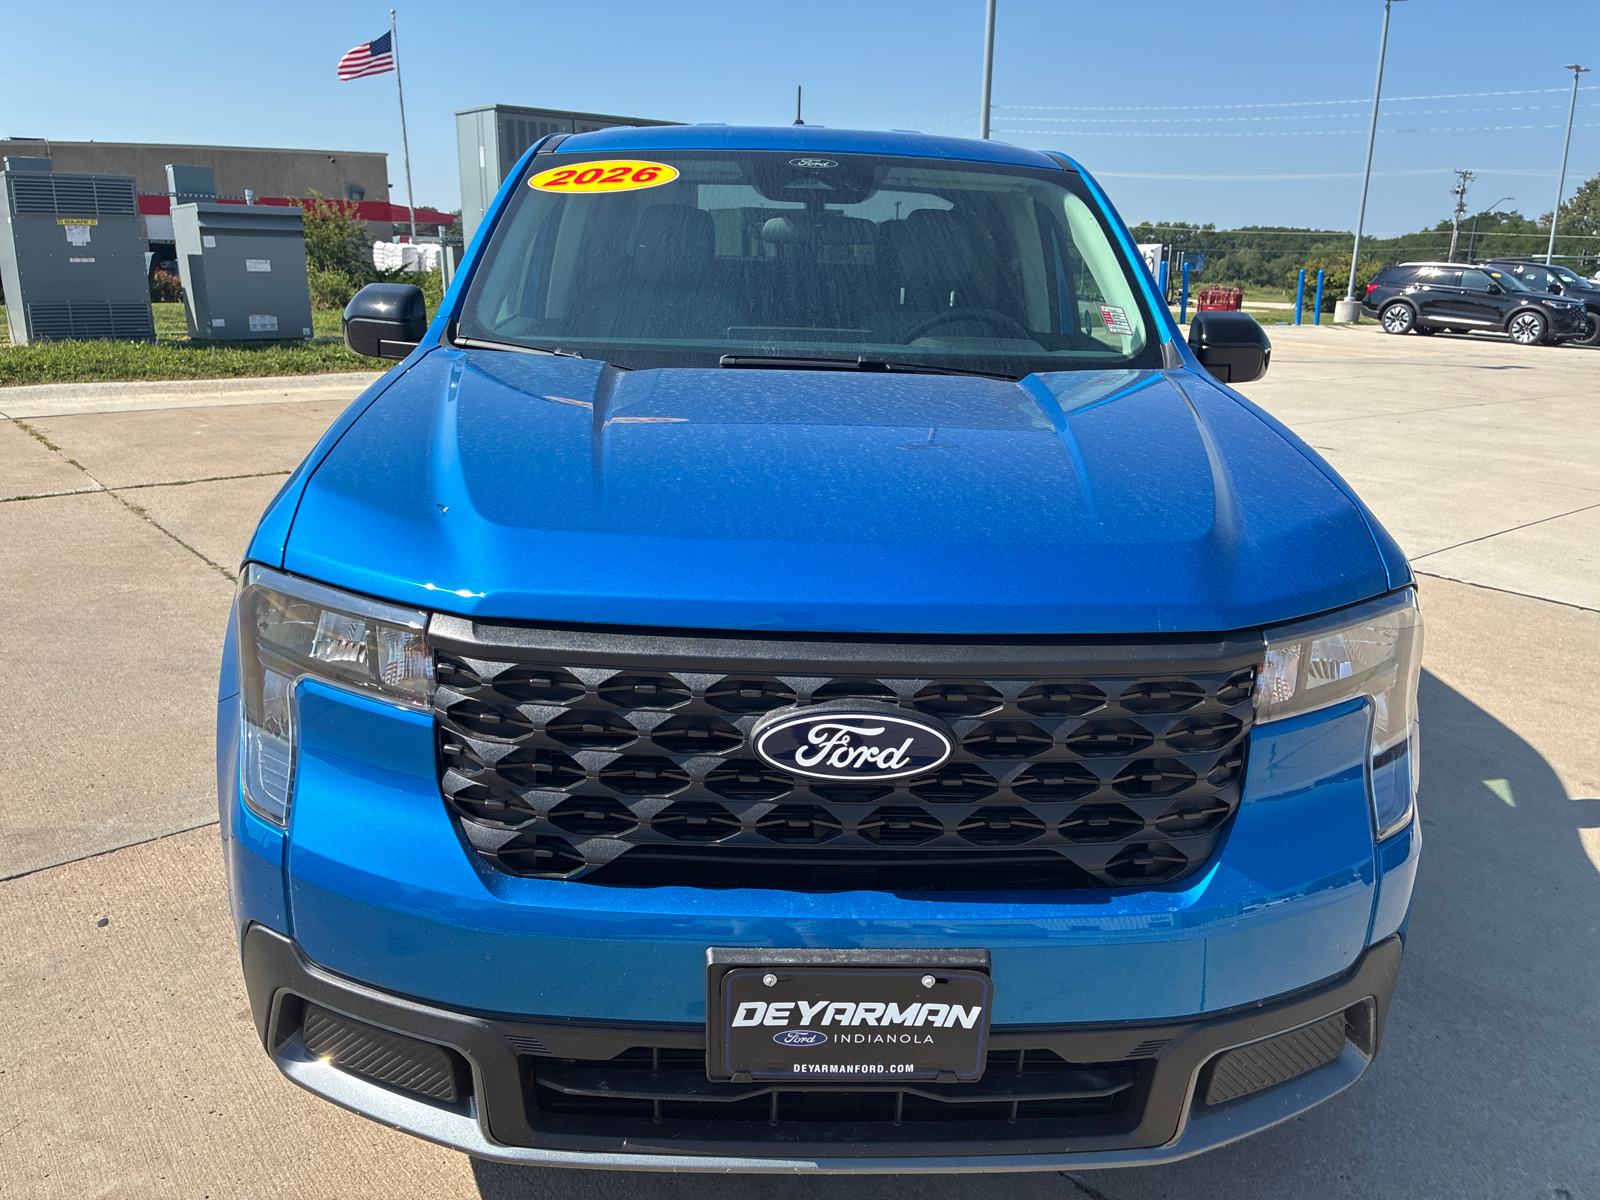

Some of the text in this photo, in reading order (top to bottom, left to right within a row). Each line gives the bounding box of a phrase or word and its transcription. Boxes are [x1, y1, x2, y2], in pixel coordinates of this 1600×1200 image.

[798, 159, 829, 167] Ford
[542, 167, 662, 187] 2026
[795, 723, 914, 769] Ford
[732, 1001, 982, 1029] DEYARMAN
[784, 1032, 934, 1044] Ford INDIANOLA
[793, 1064, 914, 1073] DEYARMANFORD.COM
